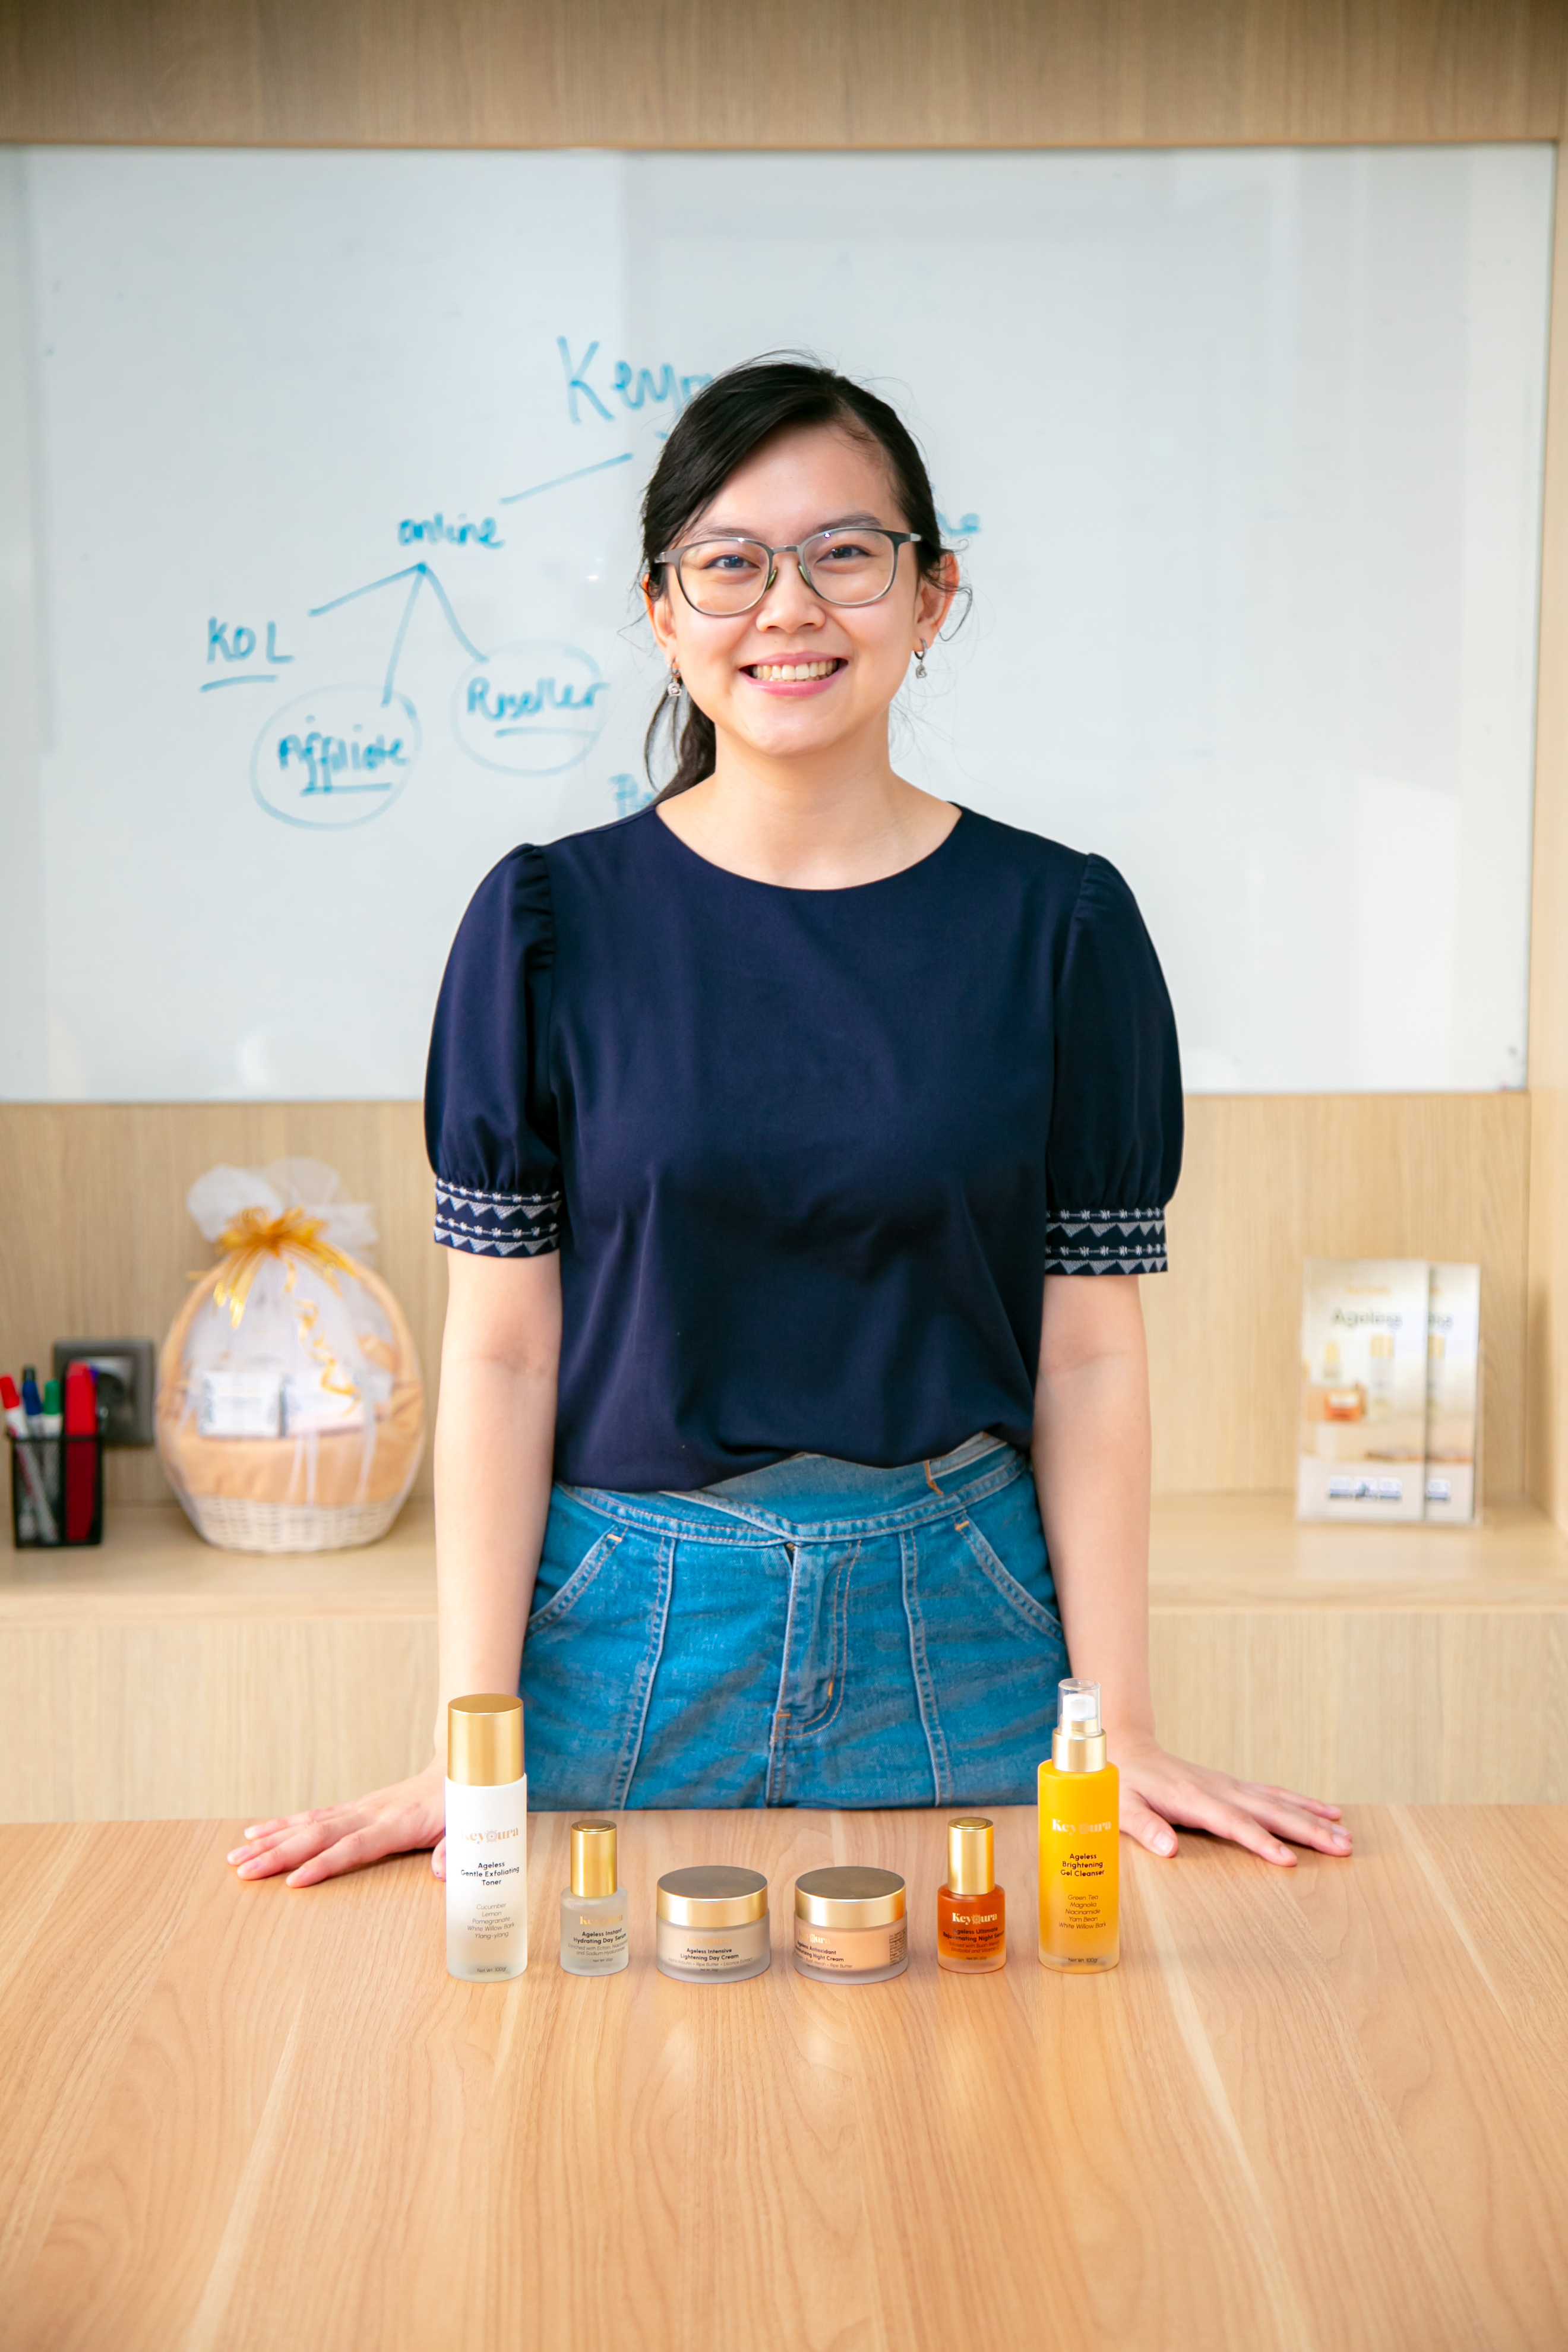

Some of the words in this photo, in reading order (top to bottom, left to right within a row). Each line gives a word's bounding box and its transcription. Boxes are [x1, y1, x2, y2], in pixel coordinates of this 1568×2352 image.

[207, 616, 295, 664] KOL
[466, 676, 611, 721] Reseller
[1070, 1853, 1097, 1861] Ageless
[478, 1861, 505, 1870] Ageless
[1062, 1860, 1104, 1870] Brightening
[460, 1869, 483, 1877] Gentle
[485, 1866, 520, 1877] Exfoliating
[1070, 1901, 1097, 1910] Magnolia
[472, 1916, 511, 1926] Pomegranate
[504, 1921, 515, 1930] Bark
[475, 1931, 509, 1940] Ylang-ylang
[605, 1928, 622, 1936] Instant
[573, 1937, 602, 1945] Hydrating
[810, 1945, 837, 1955] Antioxidant
[680, 1953, 708, 1962] Lightening
[813, 1952, 826, 1961] Night
